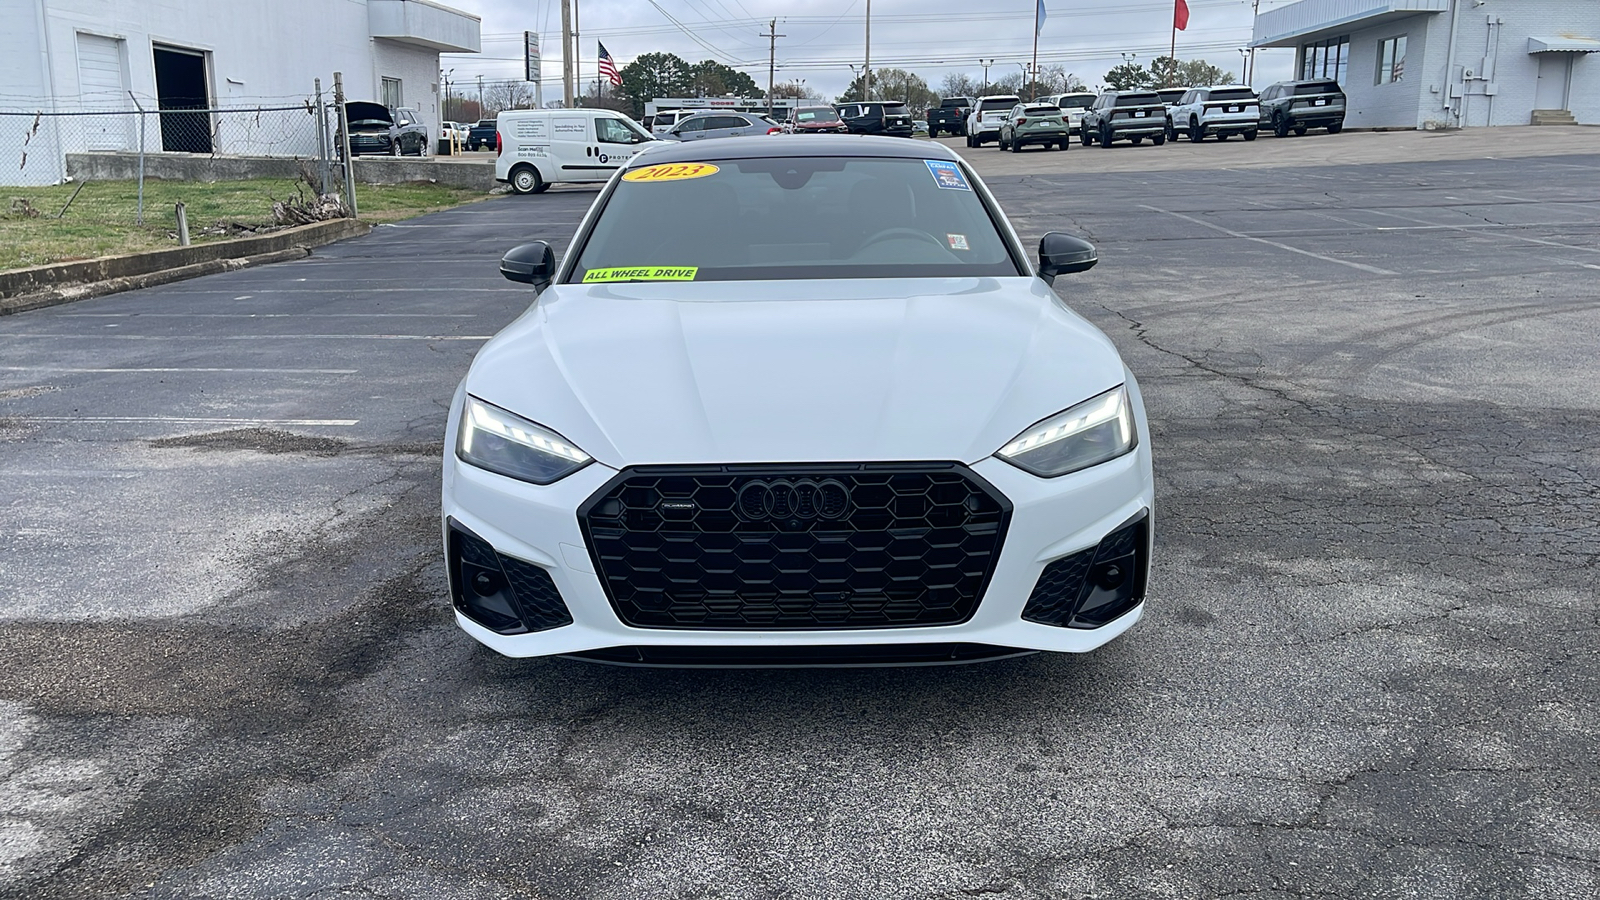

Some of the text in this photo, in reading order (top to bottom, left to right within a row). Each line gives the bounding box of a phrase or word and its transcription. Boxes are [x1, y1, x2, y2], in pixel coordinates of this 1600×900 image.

[740, 100, 757, 108] Jeep
[636, 165, 705, 179] 2023
[586, 269, 695, 280] ALL WHEEL DRIVE
